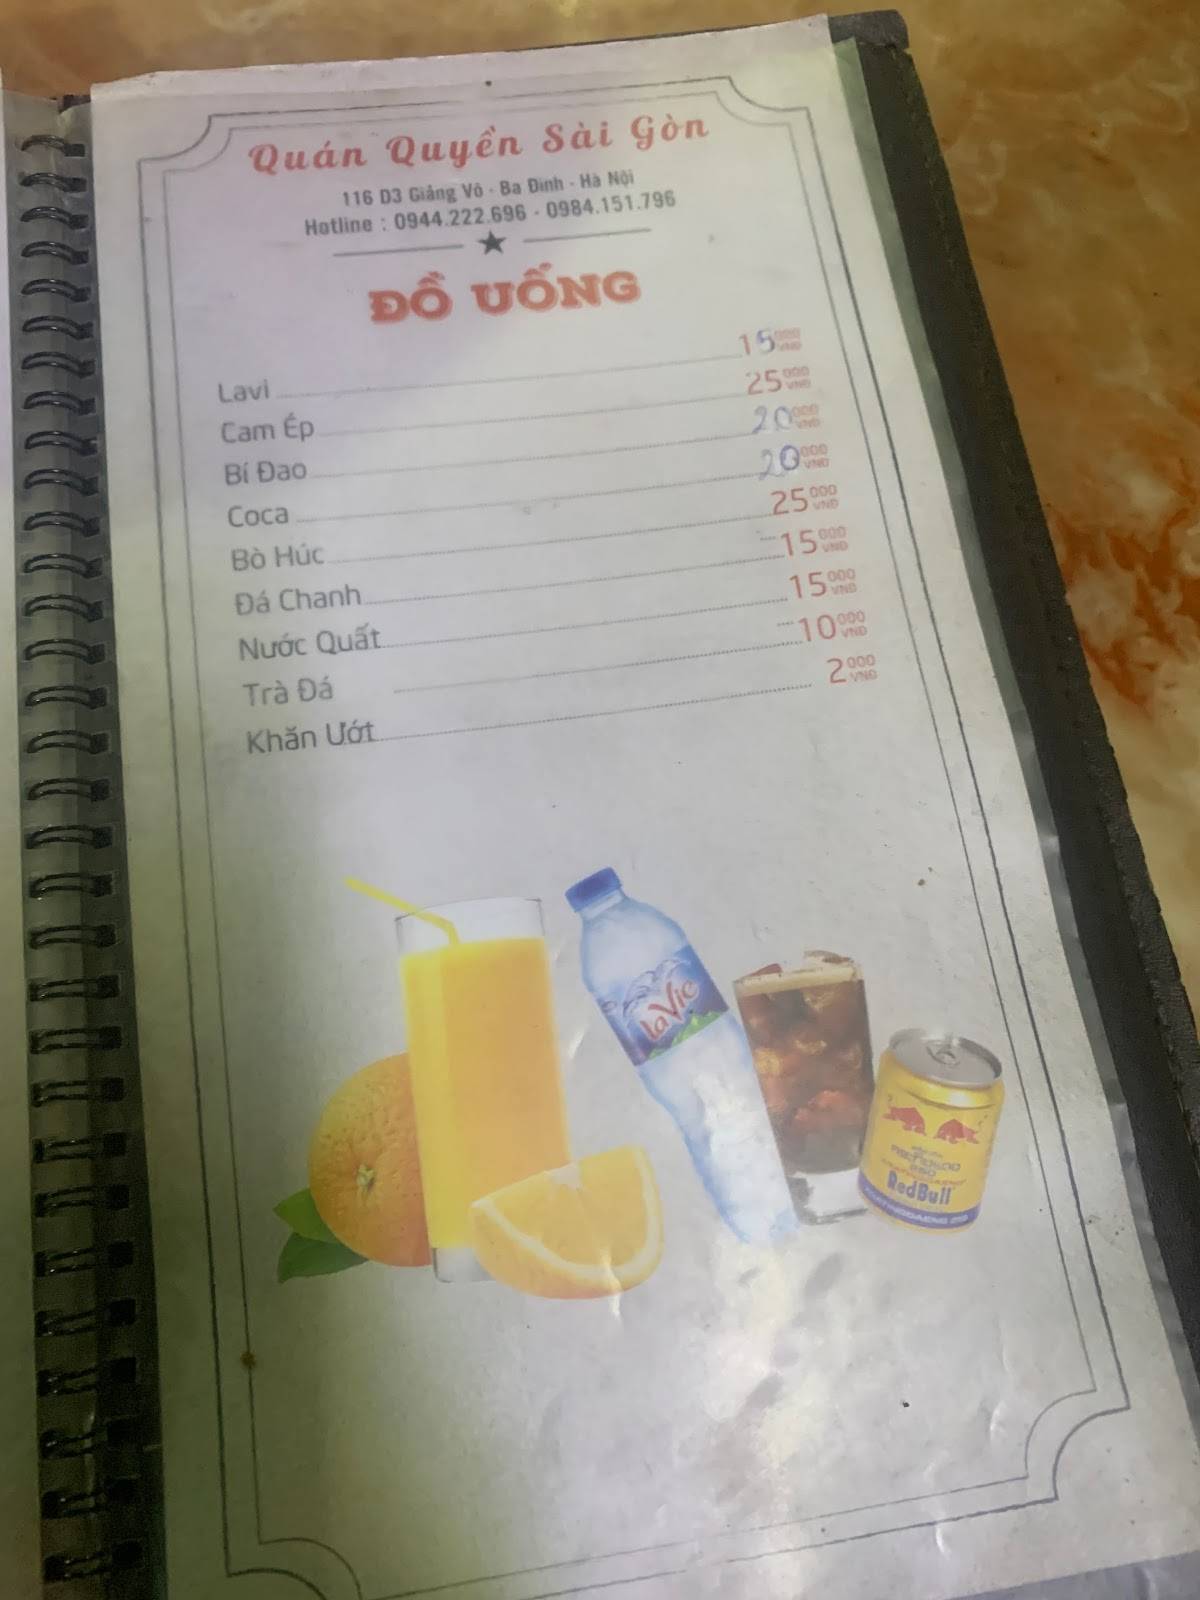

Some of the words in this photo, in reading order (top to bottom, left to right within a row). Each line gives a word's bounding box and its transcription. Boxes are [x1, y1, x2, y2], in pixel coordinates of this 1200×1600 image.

[248, 140, 367, 176] Quán
[386, 125, 523, 169] Quyền
[542, 121, 613, 153] Sài
[630, 113, 709, 150] Gòn
[343, 190, 373, 206] 116
[380, 188, 402, 204] D3
[409, 184, 457, 203] Giảng
[500, 180, 521, 196] Ba
[580, 173, 601, 189] Hà
[608, 169, 634, 187] Nội
[305, 216, 373, 236] Hotline
[394, 206, 526, 230] 0944.222.696
[546, 190, 676, 219] 0984.151.796
[368, 271, 453, 324] ĐỒ
[470, 262, 641, 315] UỐNG
[739, 328, 775, 355] 15
[218, 379, 270, 403] Lavi
[748, 369, 782, 395] 25
[221, 421, 276, 443] Cam
[283, 412, 314, 442] Ép
[752, 405, 793, 434] 20
[225, 462, 249, 485] Bí
[257, 460, 307, 483] Đao
[758, 444, 800, 480] 20
[771, 488, 808, 515] 25
[809, 484, 838, 498] 000
[228, 505, 289, 527] Coca
[781, 529, 817, 556] 15
[818, 526, 847, 540] 000
[232, 548, 266, 571] Bò
[275, 543, 325, 567] Húc
[789, 571, 826, 598] 15
[827, 568, 856, 582] 000
[235, 590, 271, 616] Đá
[279, 584, 362, 611] Chanh
[239, 633, 308, 661] Nước
[316, 622, 381, 655] Quất
[798, 614, 836, 642] 10
[836, 611, 865, 625] 000
[826, 658, 847, 684] 2
[846, 654, 876, 668] 000
[243, 680, 289, 706] Trà
[298, 676, 334, 702] Đá
[247, 726, 317, 754] Khăn
[326, 719, 375, 746] Ướt
